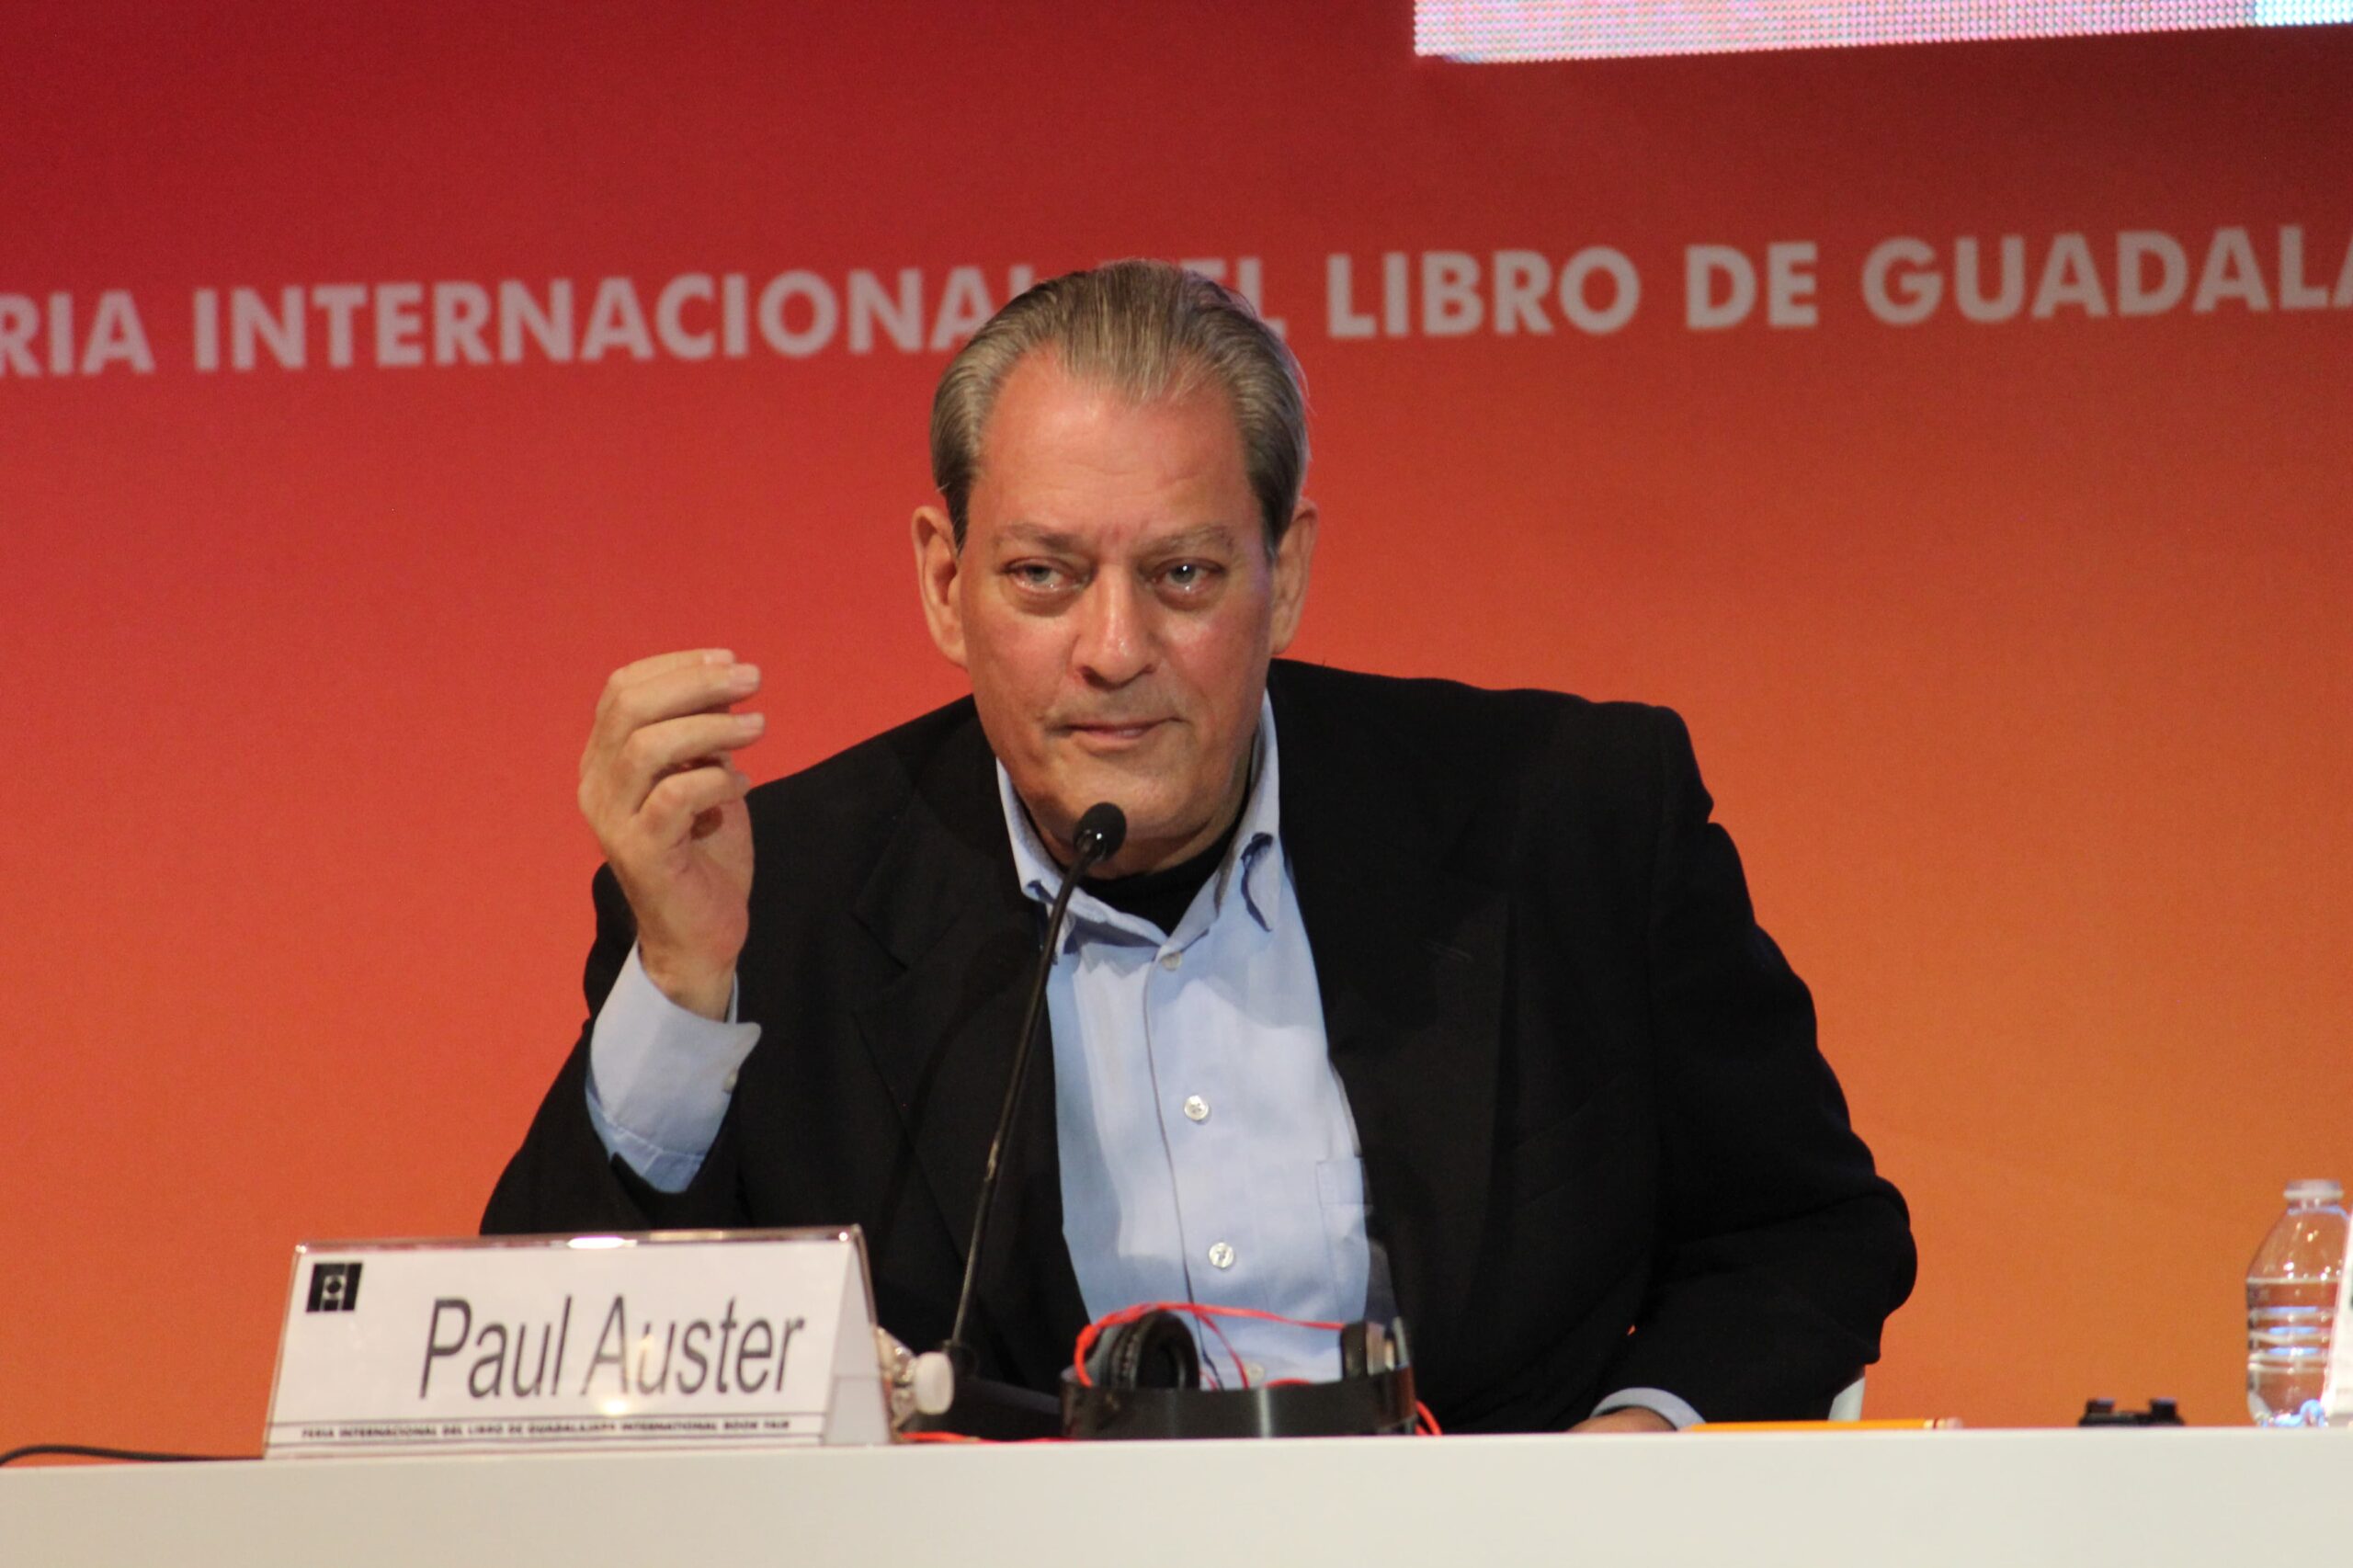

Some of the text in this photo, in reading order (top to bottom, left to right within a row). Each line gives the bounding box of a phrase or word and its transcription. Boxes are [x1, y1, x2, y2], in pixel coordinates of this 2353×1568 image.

[1326, 244, 1641, 338] LIBRO
[1685, 241, 1818, 331] DE
[1860, 224, 2353, 327] GUADAL
[420, 1294, 806, 1399] Paul Auster
